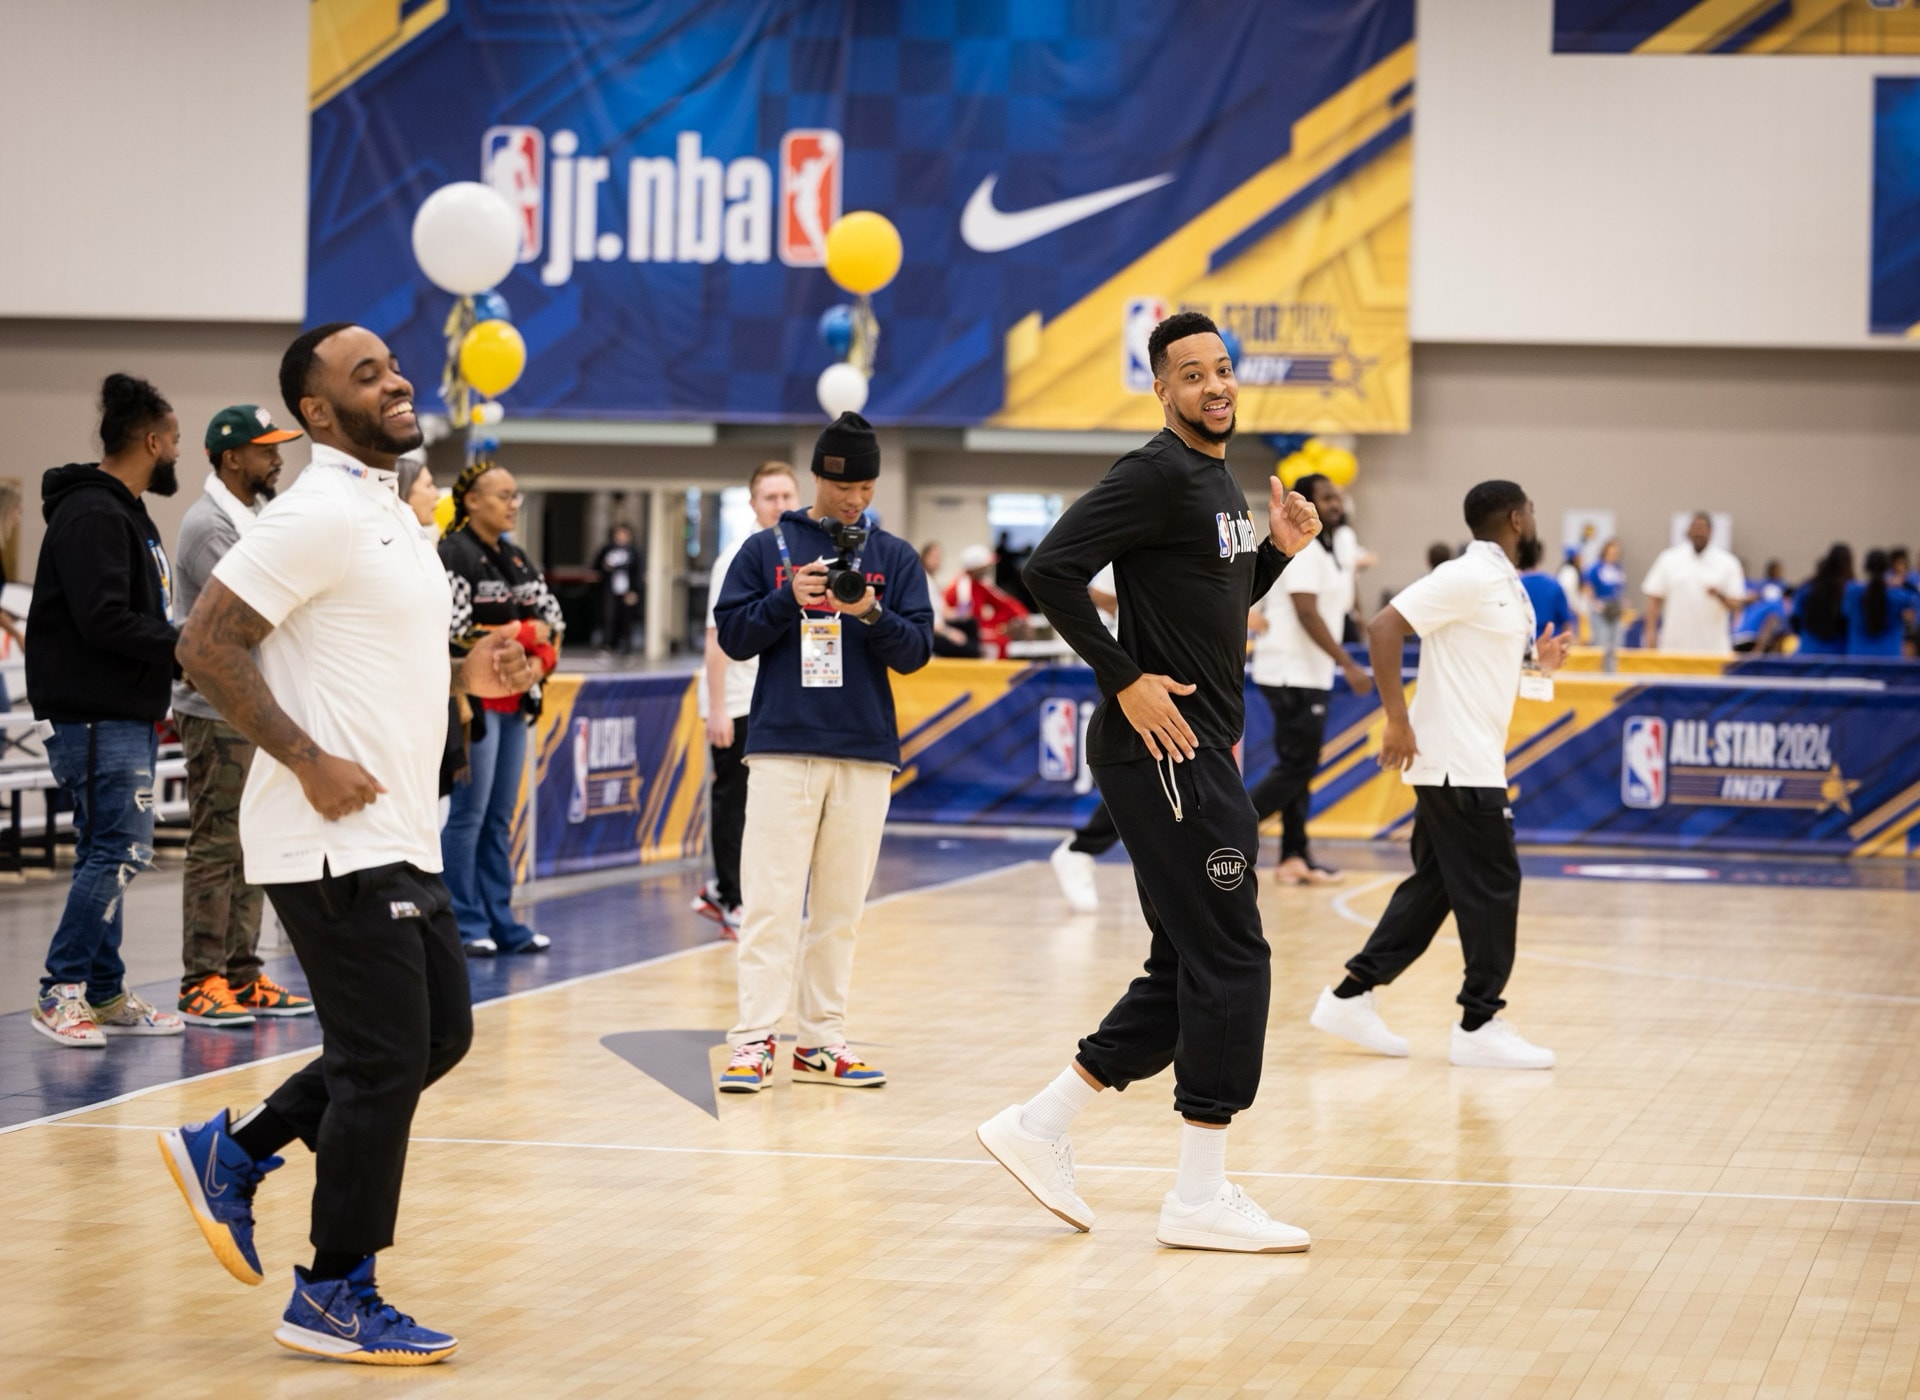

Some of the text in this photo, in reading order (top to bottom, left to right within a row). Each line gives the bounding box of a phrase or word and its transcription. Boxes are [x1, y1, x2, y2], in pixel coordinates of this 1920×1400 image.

[541, 129, 773, 286] jr.nba
[1776, 722, 1831, 769] 2024
[1720, 775, 1783, 800] INDY
[1212, 861, 1242, 877] NOLA
